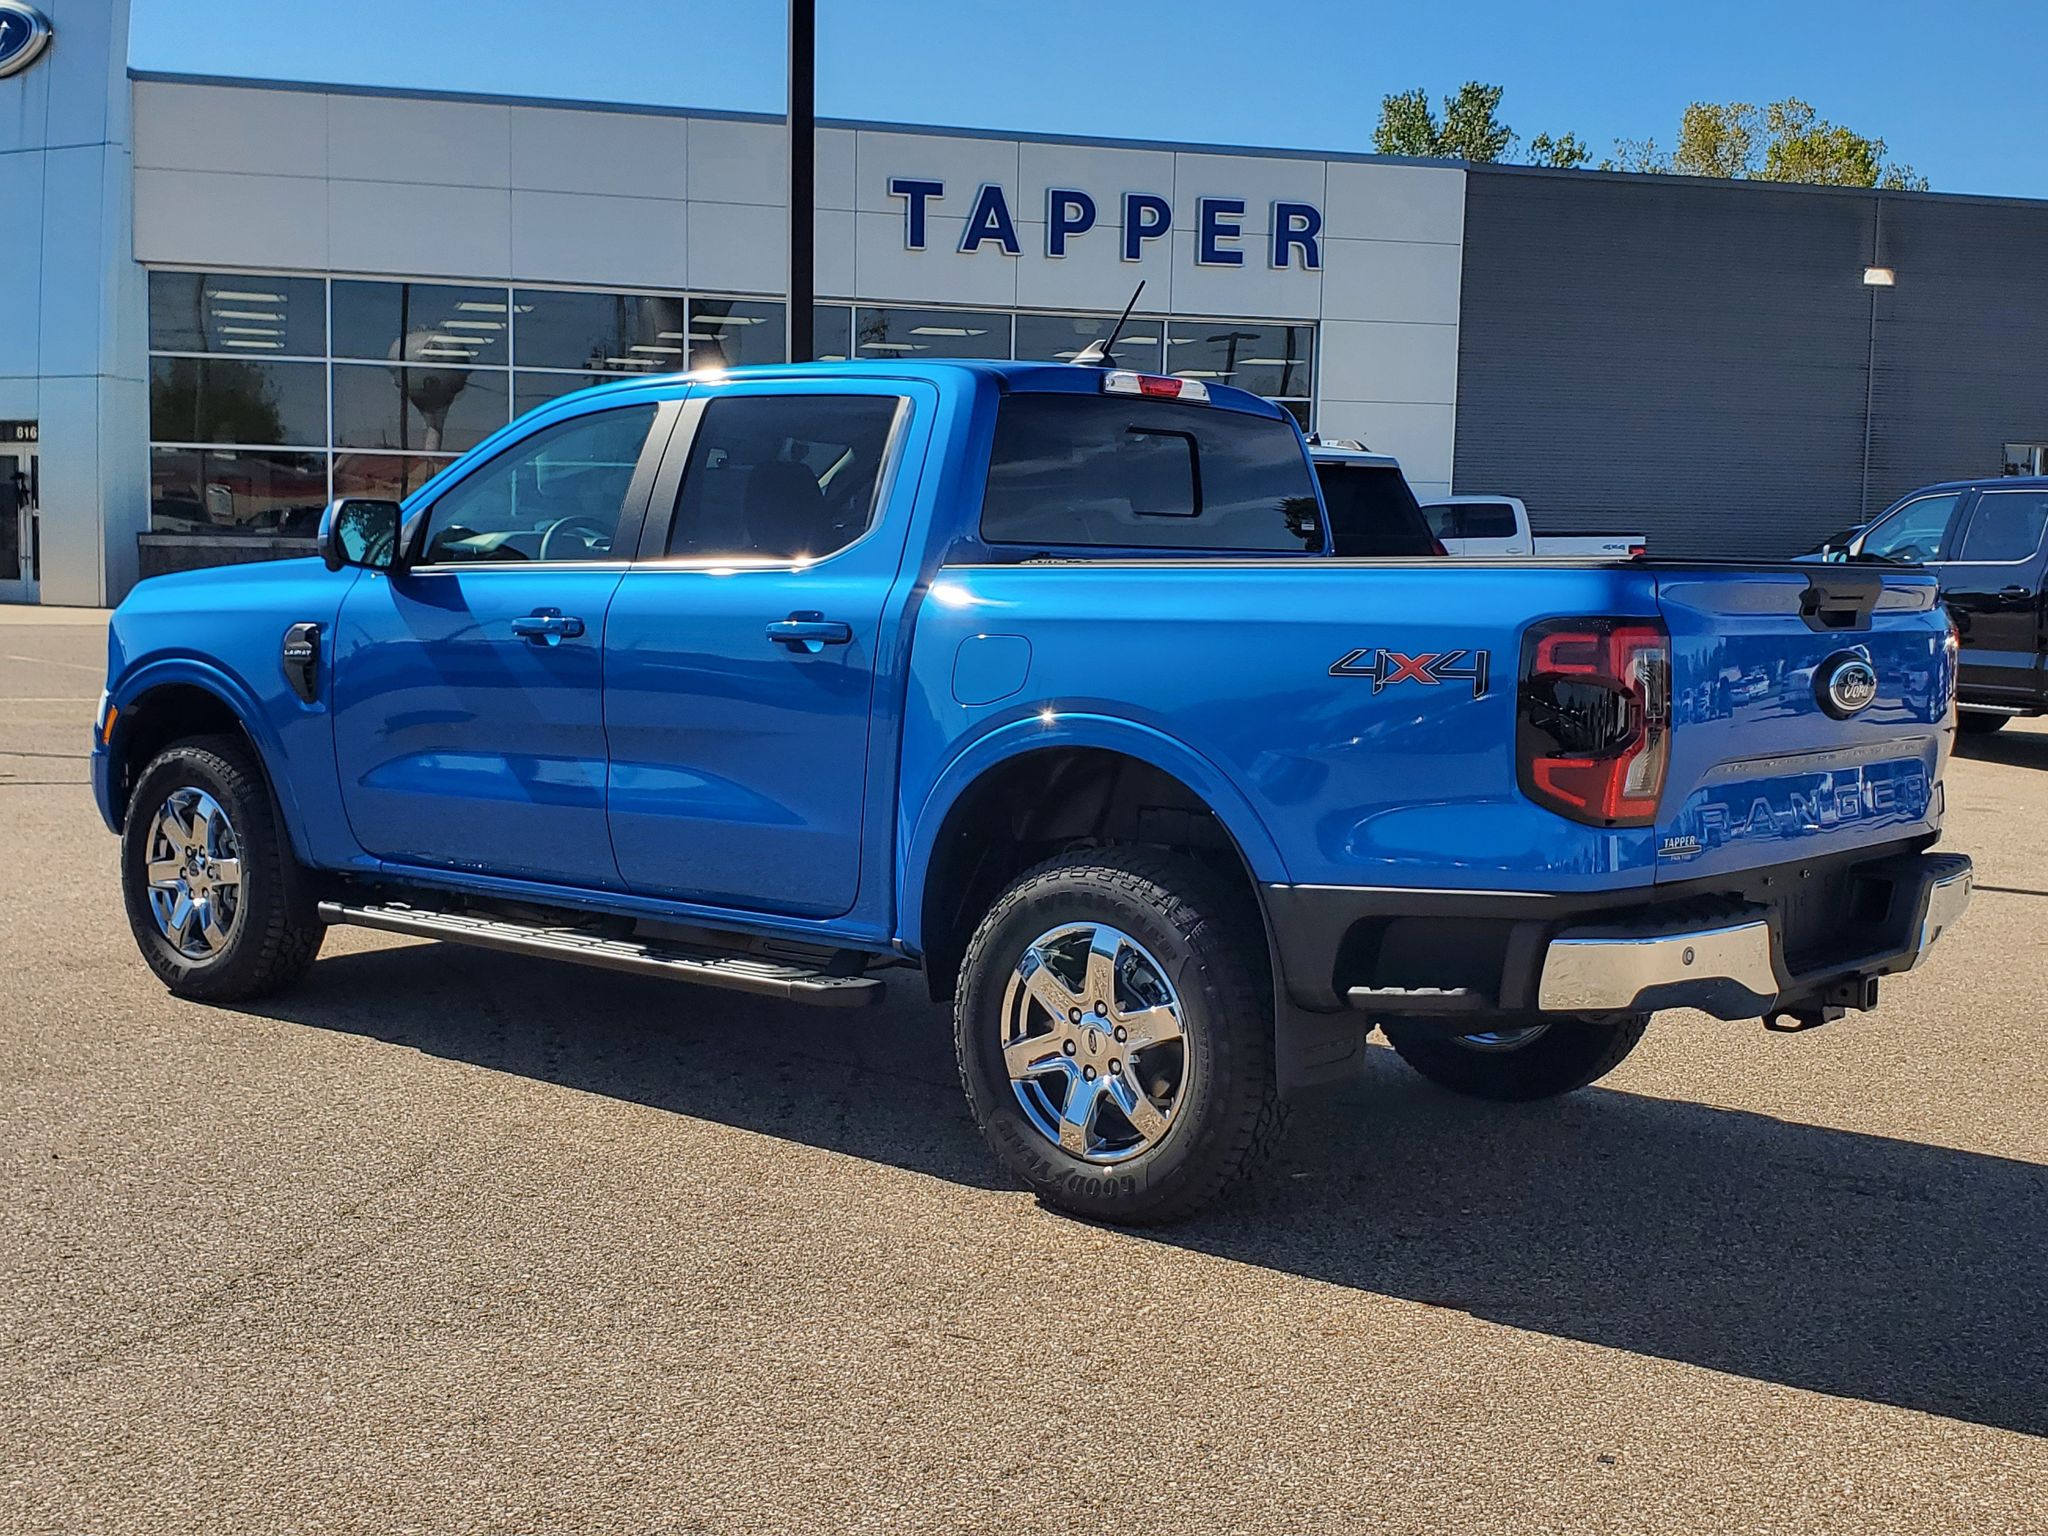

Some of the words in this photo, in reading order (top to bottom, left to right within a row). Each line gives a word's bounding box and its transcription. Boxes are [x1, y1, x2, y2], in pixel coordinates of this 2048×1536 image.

[888, 177, 1323, 269] TAPPER
[17, 426, 37, 439] 816
[1694, 773, 1924, 843] RANGER
[1664, 835, 1696, 848] TAPPER
